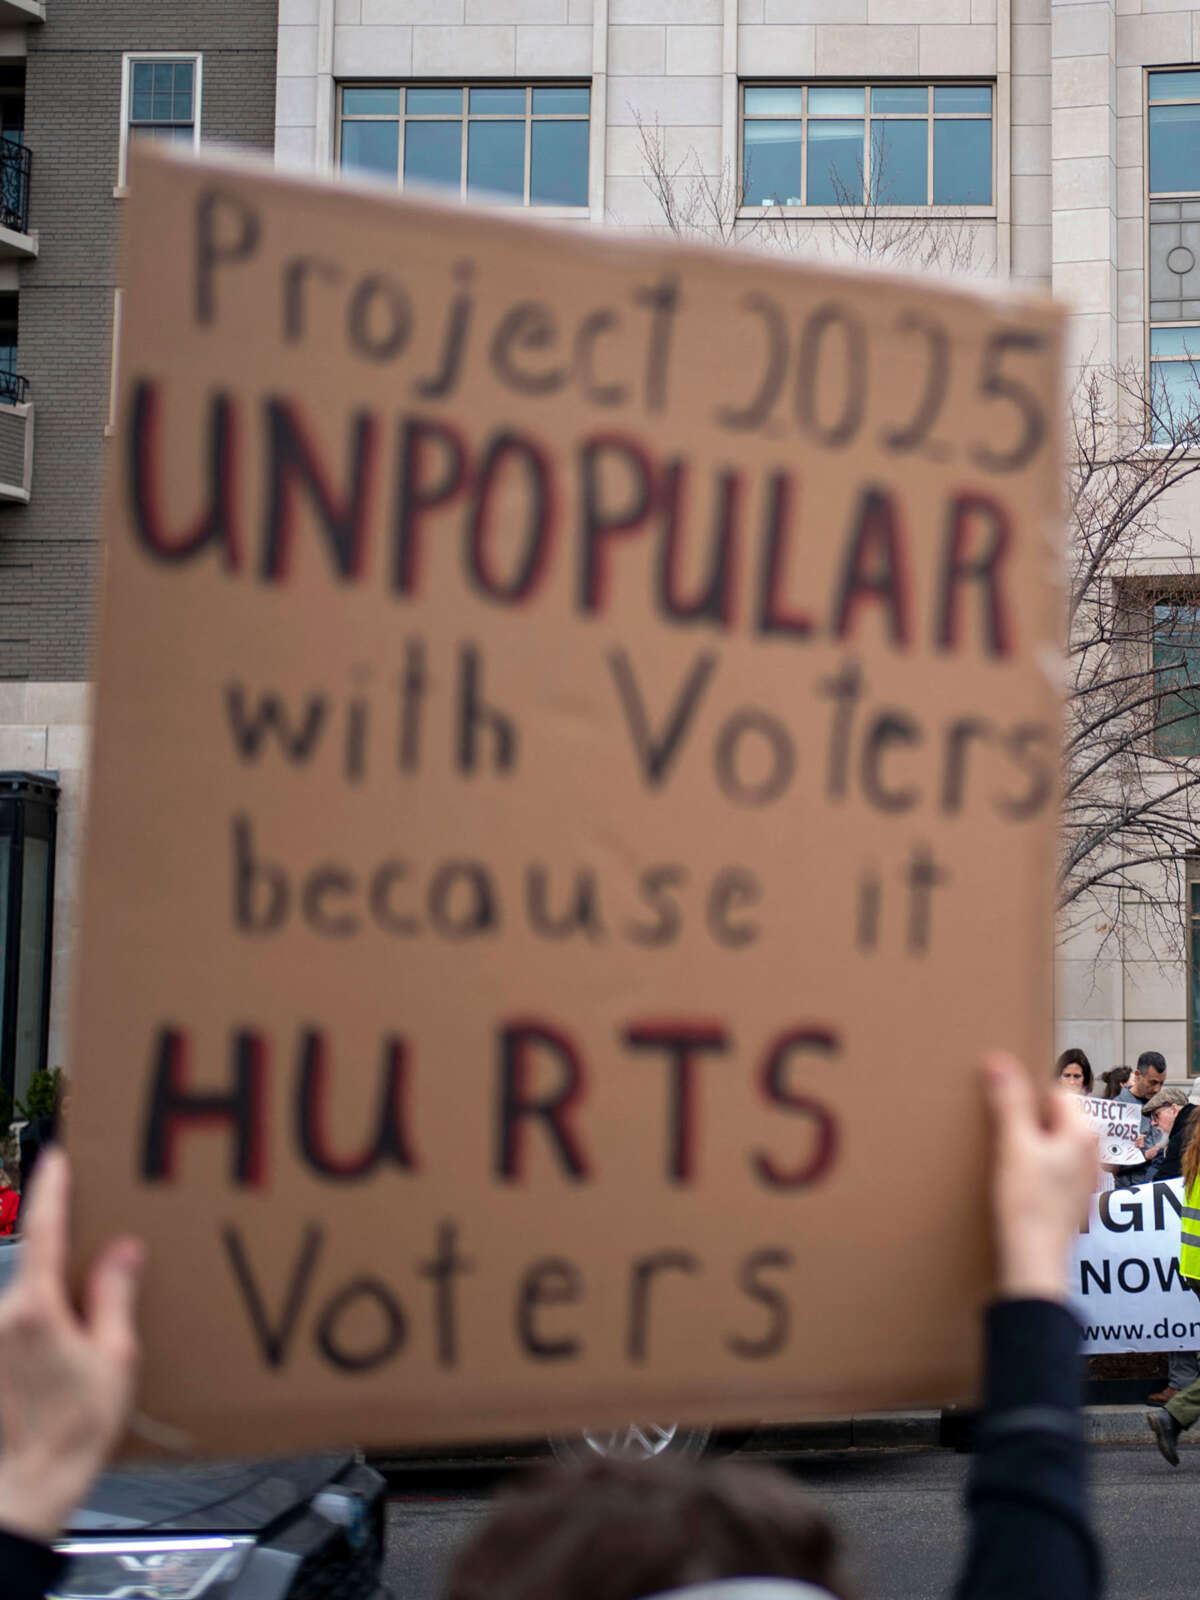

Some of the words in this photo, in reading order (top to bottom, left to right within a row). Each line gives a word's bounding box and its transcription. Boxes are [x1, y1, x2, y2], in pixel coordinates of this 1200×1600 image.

[193, 190, 680, 416] Project
[715, 298, 1051, 476] 2025
[127, 373, 1018, 663] UNPOPULAR
[225, 640, 518, 783] with
[605, 648, 1060, 820] Voters
[233, 814, 763, 950] because
[857, 836, 950, 957] it
[139, 1016, 847, 1193] HURTS
[1083, 1100, 1127, 1121] OJECT
[1107, 1122, 1139, 1142] 2025
[221, 1220, 795, 1376] Voters
